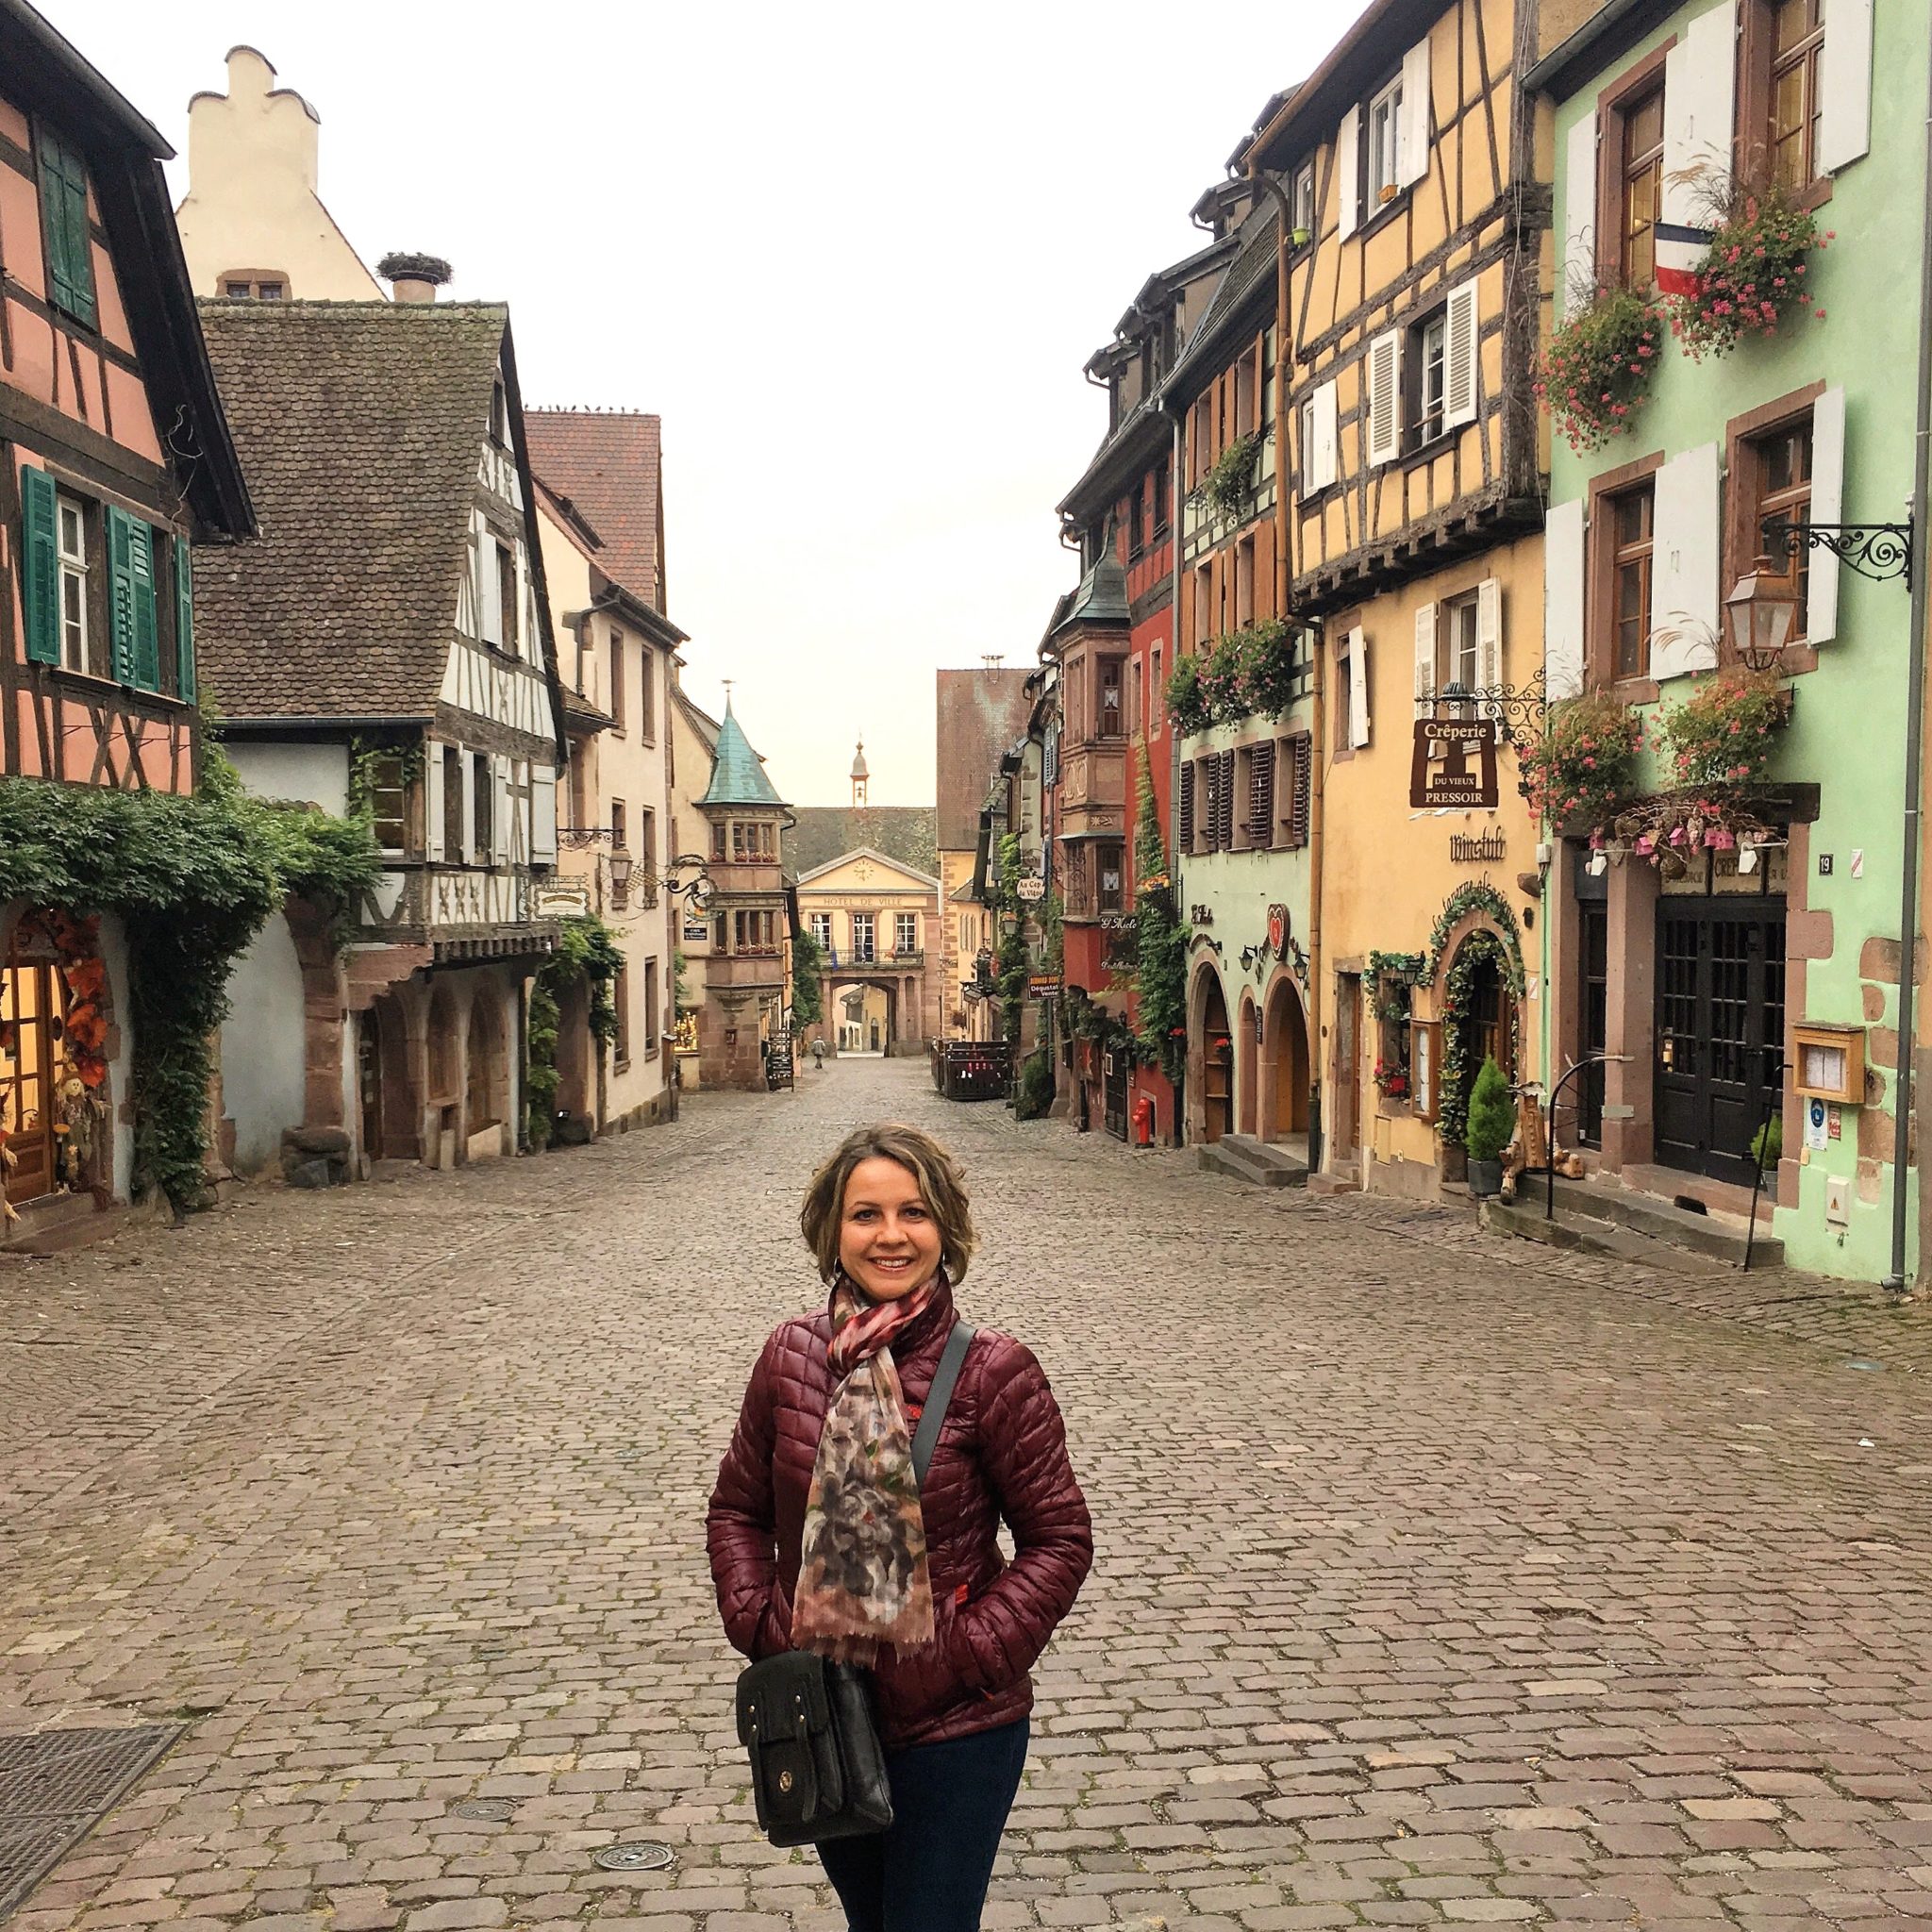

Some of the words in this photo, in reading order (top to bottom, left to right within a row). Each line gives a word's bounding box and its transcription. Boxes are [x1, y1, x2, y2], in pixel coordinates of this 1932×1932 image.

[1424, 724, 1487, 741] Crêperie
[1425, 792, 1483, 803] PRESSOIR
[1821, 858, 1830, 872] 19
[860, 897, 873, 906] DE
[879, 897, 903, 906] VILLE
